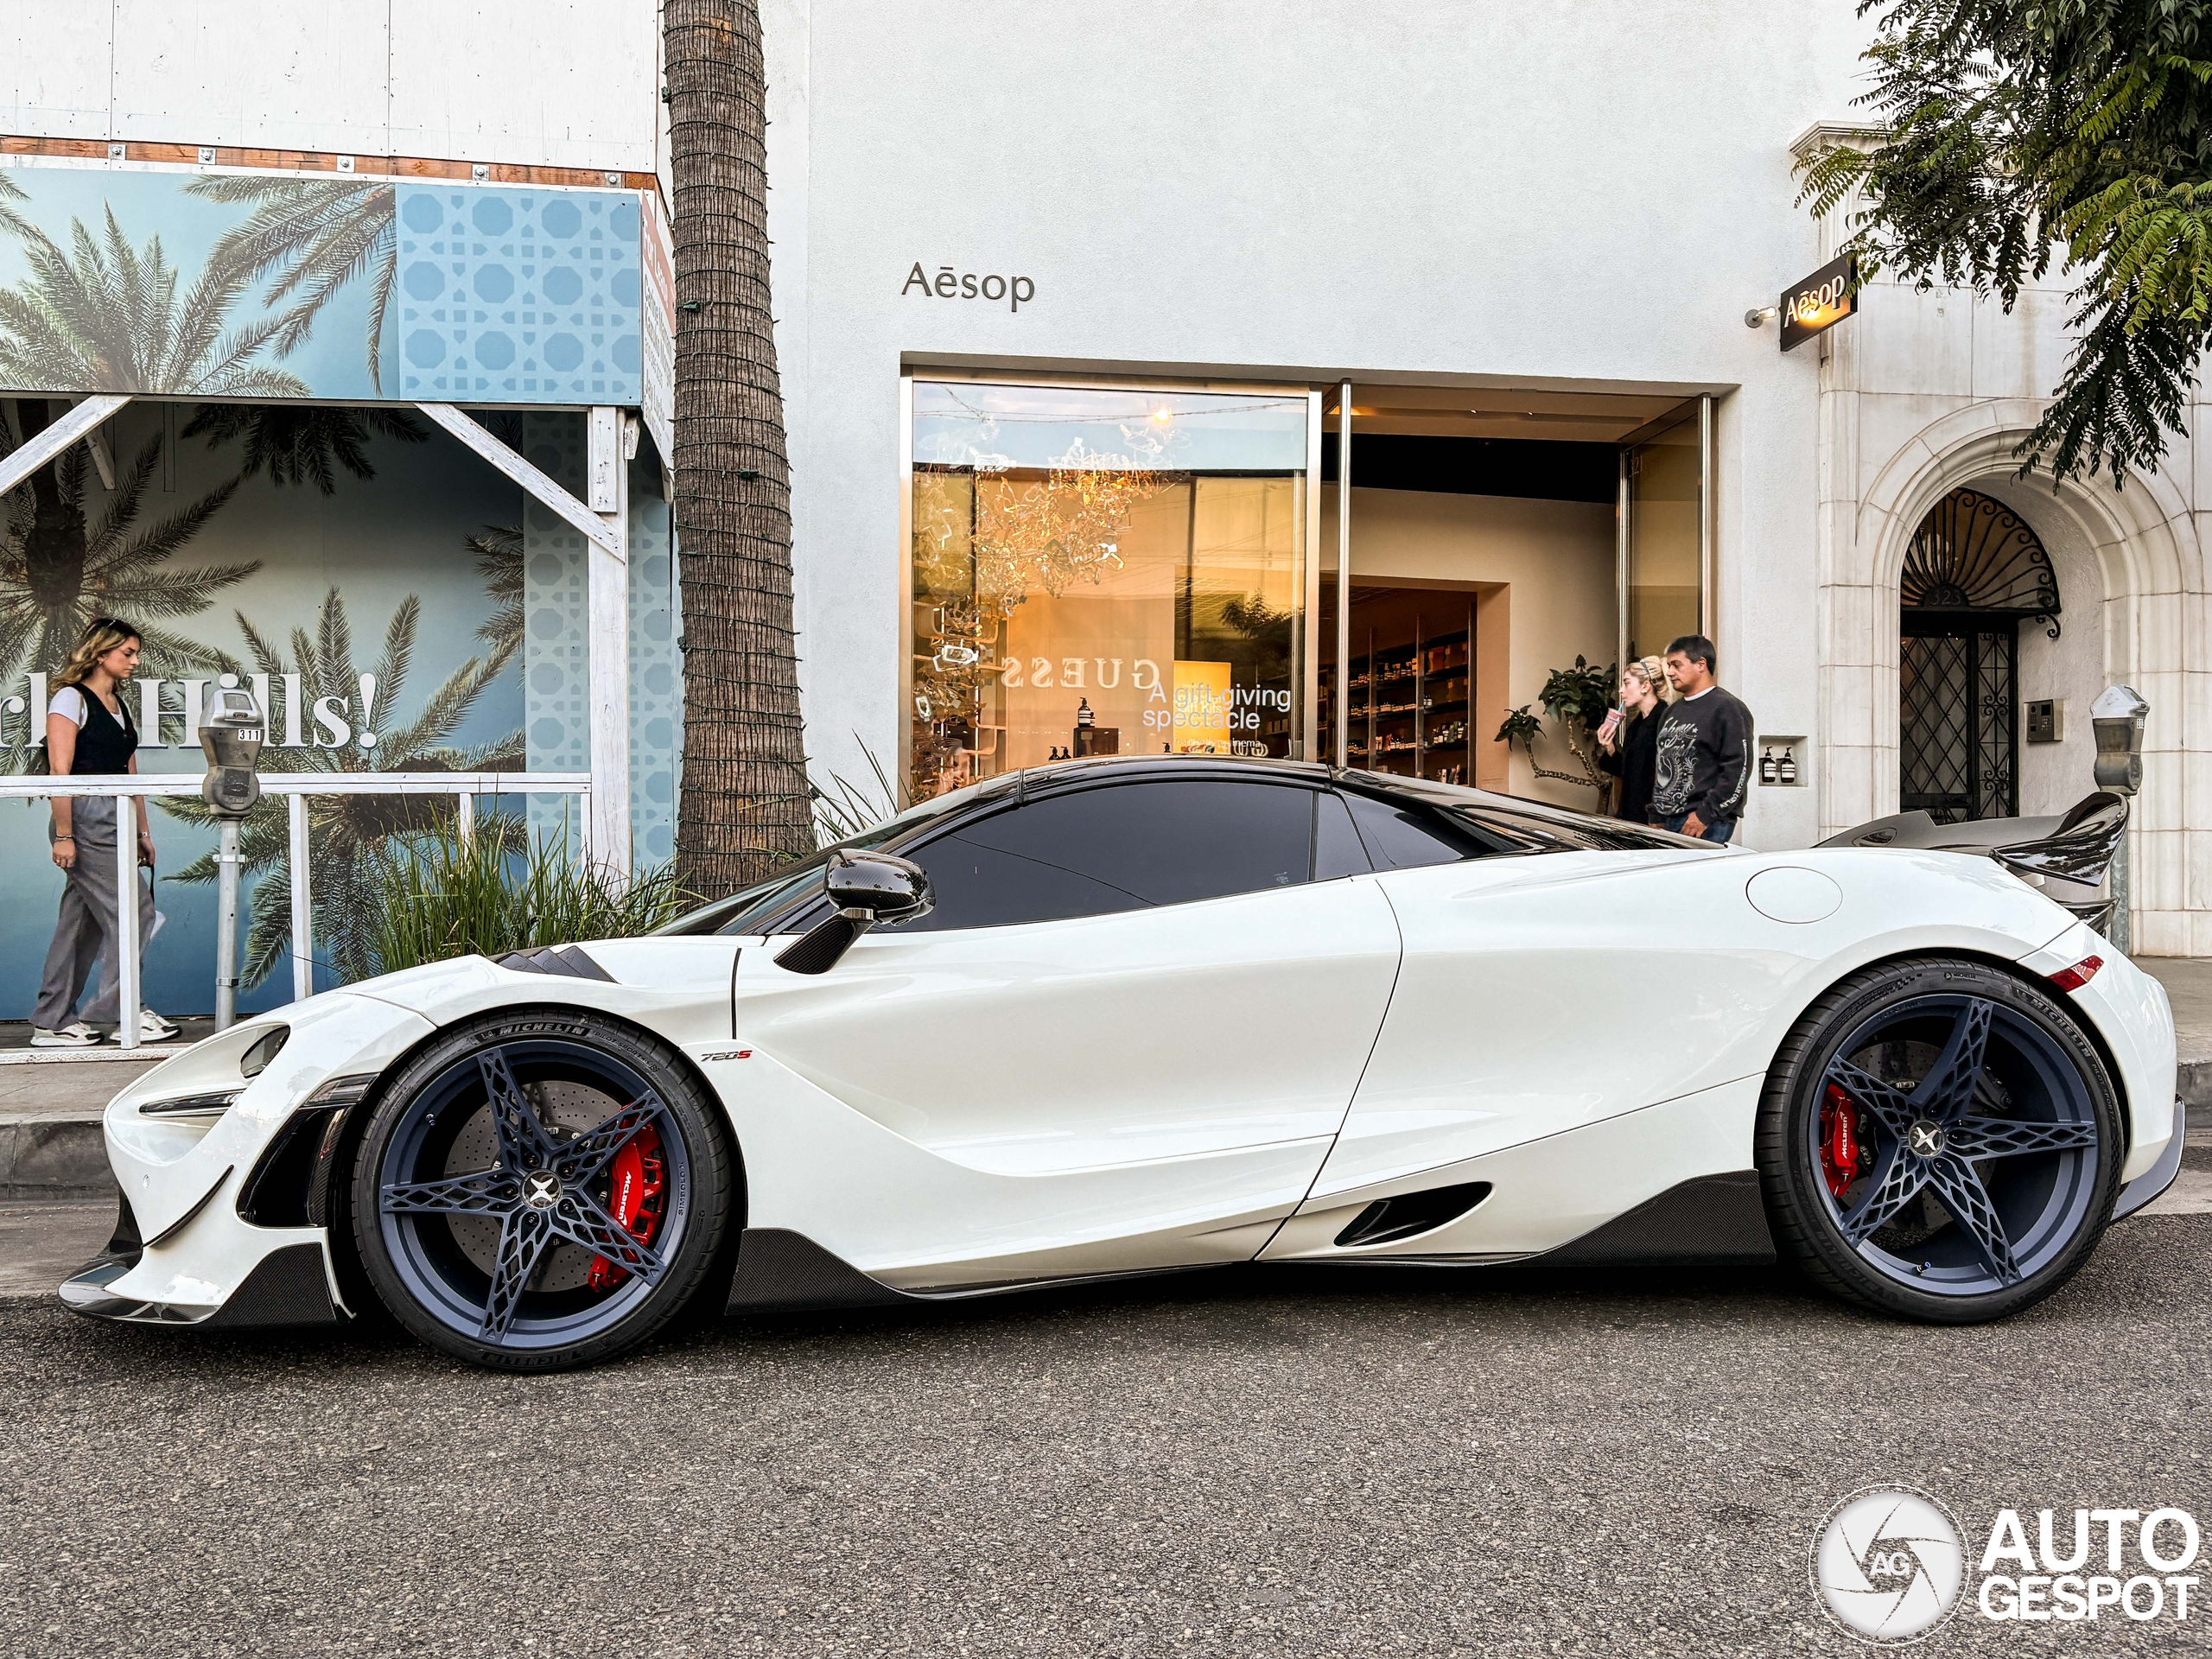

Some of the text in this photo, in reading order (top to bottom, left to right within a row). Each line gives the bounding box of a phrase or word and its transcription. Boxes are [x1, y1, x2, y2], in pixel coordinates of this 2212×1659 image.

[644, 214, 653, 268] For
[901, 261, 1035, 313] Aēsop
[1783, 275, 1846, 328] Aēsop
[1929, 589, 1961, 605] 323
[0, 672, 378, 749] rl Hlls!
[1148, 682, 1291, 713] A gift-giving
[239, 729, 258, 741] 311
[1142, 707, 1261, 733] spectacle
[499, 1022, 587, 1036] MICHELIN
[2031, 997, 2092, 1058] MICHELIN
[594, 1032, 617, 1045] PILOT
[618, 1041, 642, 1058] SPORT
[701, 1050, 753, 1062] 720S
[2092, 1064, 2105, 1086] PILOT
[619, 1171, 632, 1220] McLaren
[677, 1171, 686, 1216] SIMBOLO
